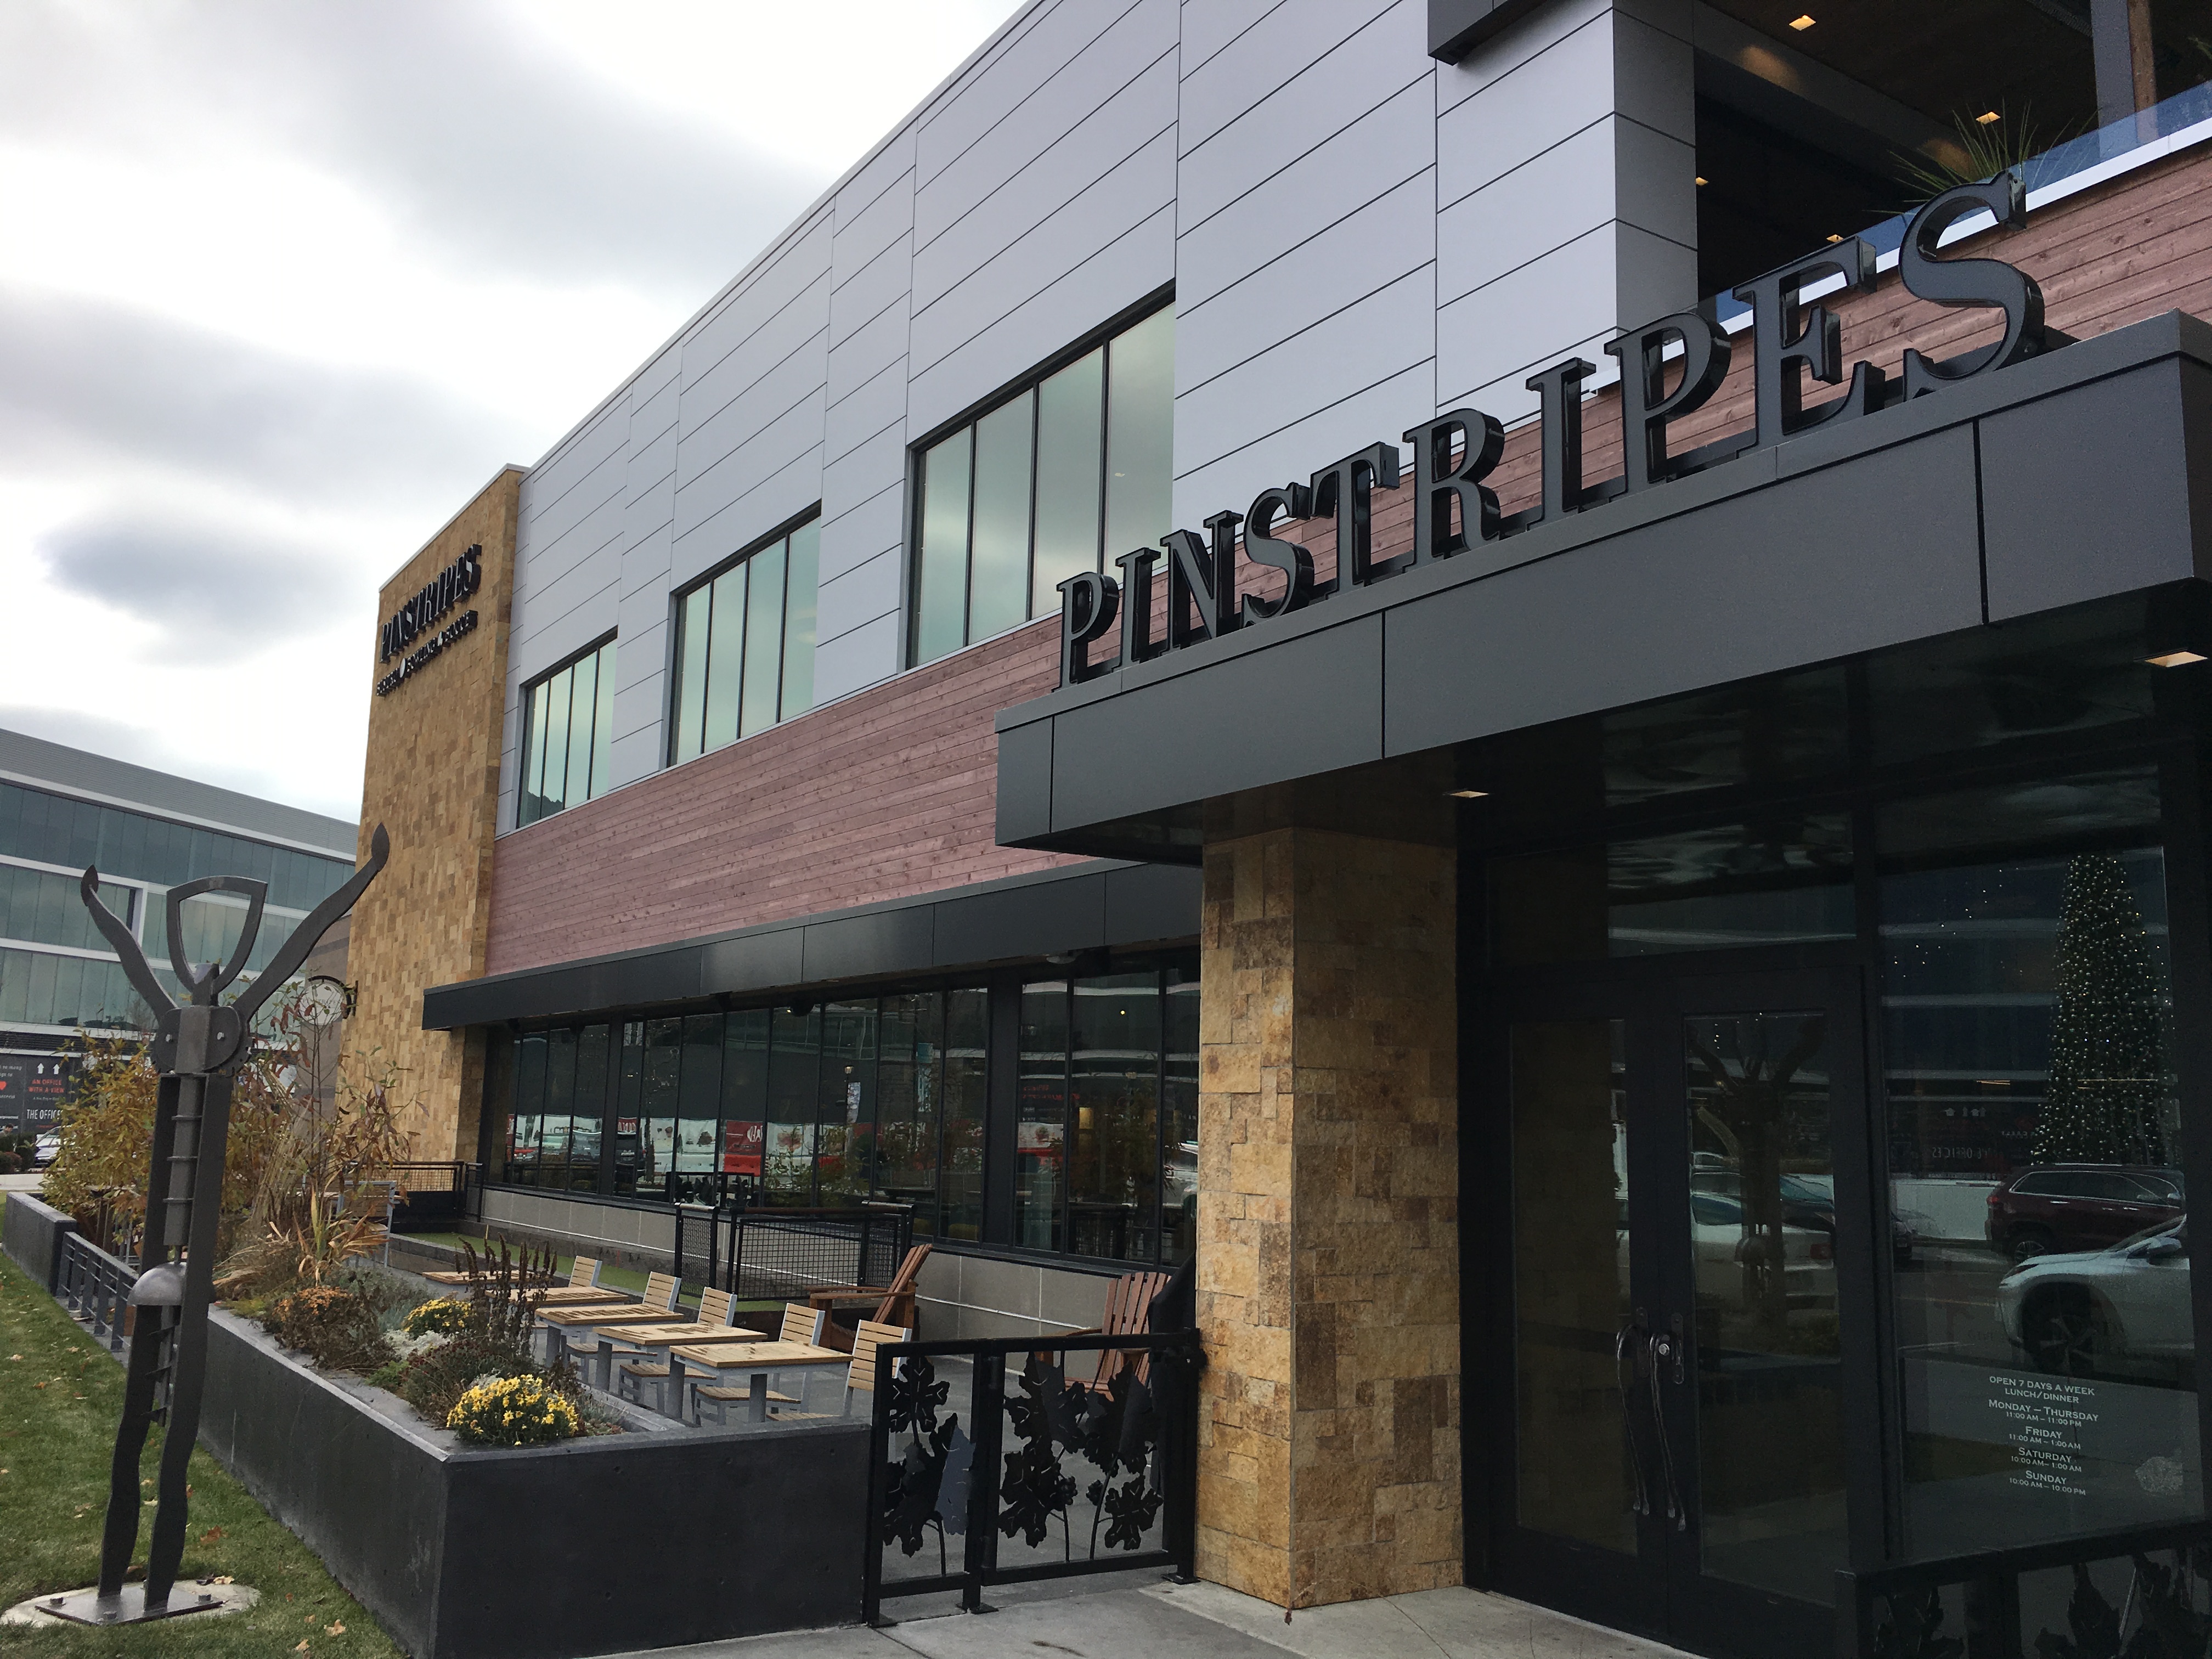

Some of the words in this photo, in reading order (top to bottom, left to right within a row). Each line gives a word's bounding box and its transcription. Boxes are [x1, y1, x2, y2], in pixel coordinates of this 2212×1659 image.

[1056, 171, 2045, 692] PINSTRIPES
[380, 544, 482, 664] PINSTRIPES
[27, 1109, 38, 1119] THE
[1989, 1375, 2016, 1386] OPEN
[2027, 1381, 2053, 1391] DAYS
[2064, 1385, 2095, 1396] WEEK
[2005, 1387, 2079, 1403] LUNCH/DINNER
[1988, 1399, 2032, 1413] MONDAY
[2043, 1406, 2099, 1421] THURSDAY
[2006, 1411, 2025, 1420] 11:00
[2048, 1417, 2068, 1426] 11:00
[2025, 1426, 2062, 1439] FRIDAY
[2009, 1434, 2028, 1442] 11:00
[2051, 1440, 2067, 1448] 1:00
[2011, 1455, 2031, 1464] 10:00
[2052, 1462, 2068, 1471] 1:00
[2018, 1447, 2072, 1463] SATURDAY
[2010, 1477, 2029, 1486] 10:00
[2025, 1470, 2067, 1485] SUNDAY
